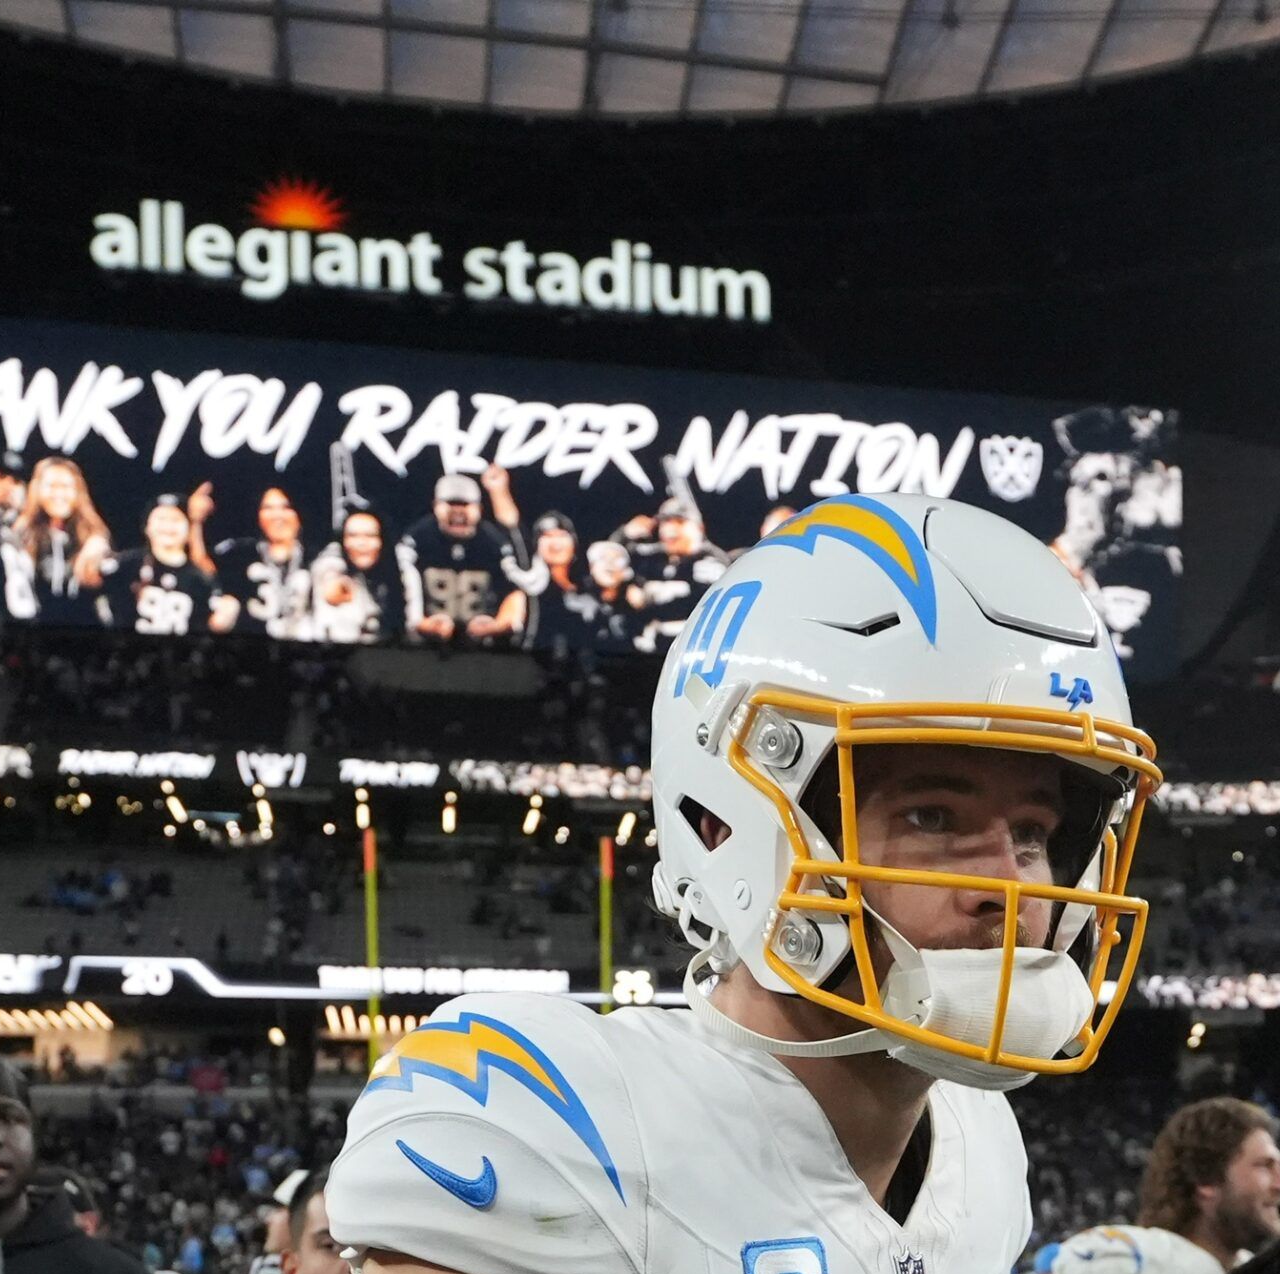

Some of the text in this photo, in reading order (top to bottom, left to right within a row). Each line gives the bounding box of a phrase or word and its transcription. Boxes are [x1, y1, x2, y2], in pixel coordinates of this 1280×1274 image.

[91, 200, 770, 321] allegiant stadium
[153, 369, 323, 471] YOU
[339, 385, 658, 493] RAIDER
[675, 408, 975, 499] NATION
[673, 580, 763, 698] 10
[1050, 671, 1093, 712] LA
